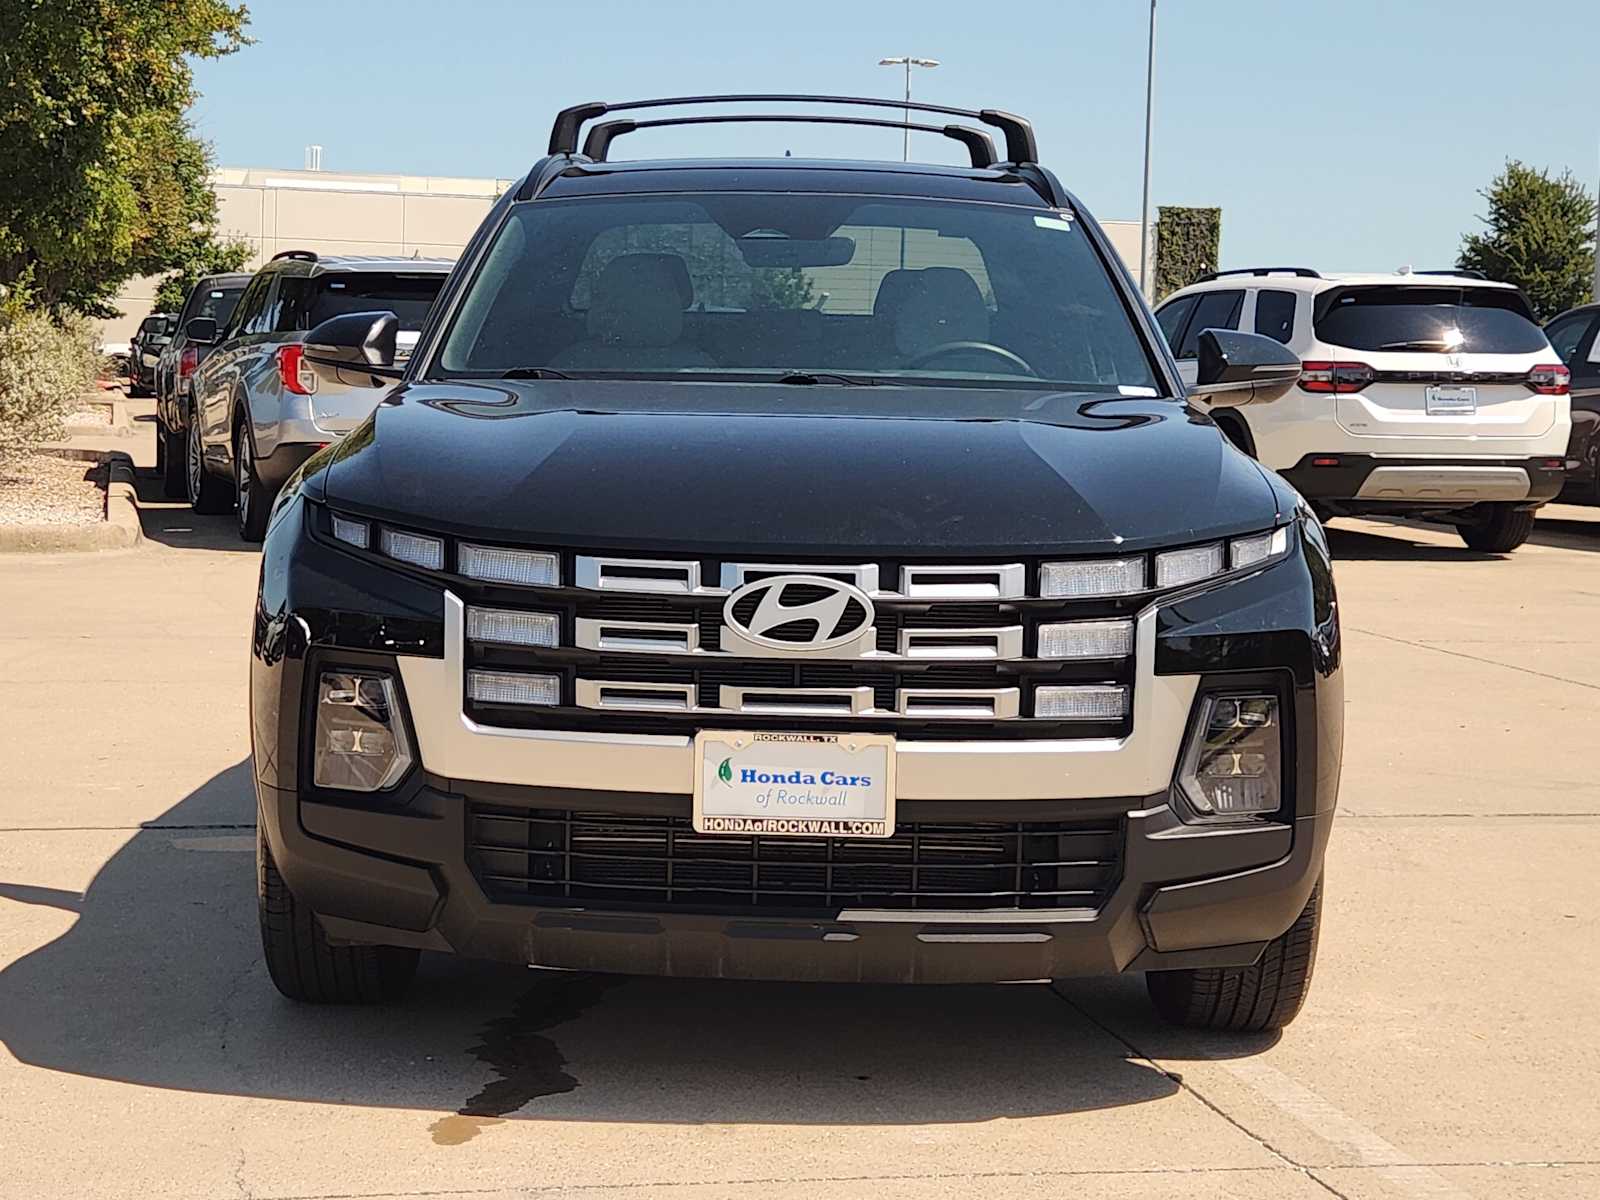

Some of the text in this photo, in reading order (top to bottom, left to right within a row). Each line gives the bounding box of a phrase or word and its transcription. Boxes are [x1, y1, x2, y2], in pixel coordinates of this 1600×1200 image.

[822, 735, 838, 743] TX
[740, 768, 871, 787] Honda Cars
[756, 788, 848, 808] of Rockwall
[704, 818, 885, 835] HONDAofROCKWALL.COM
